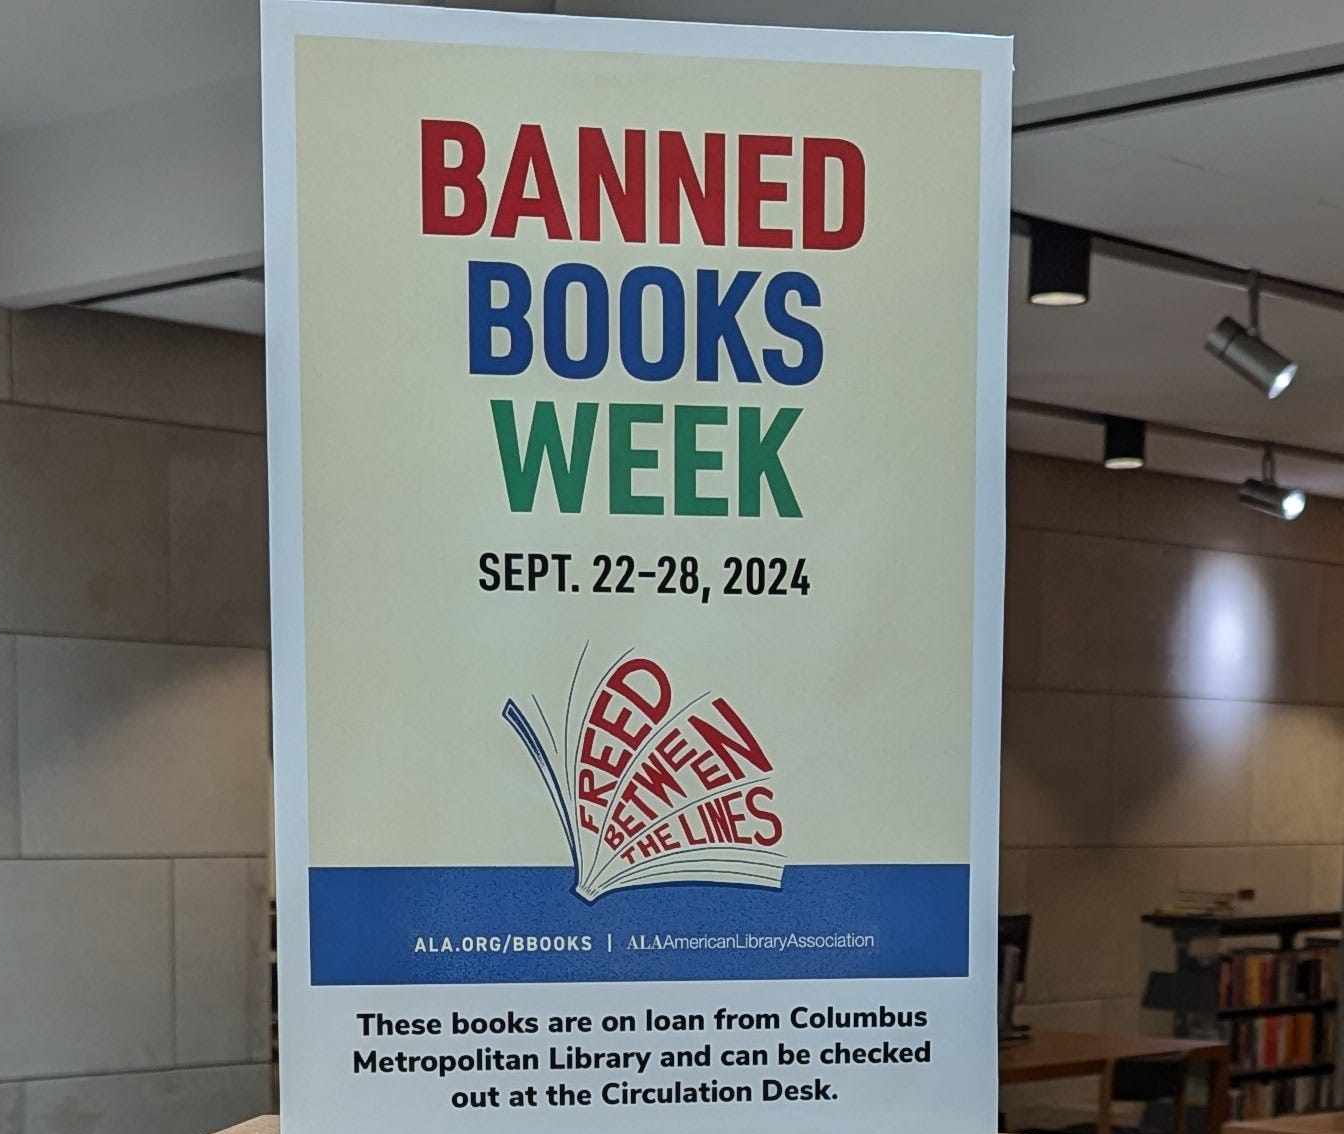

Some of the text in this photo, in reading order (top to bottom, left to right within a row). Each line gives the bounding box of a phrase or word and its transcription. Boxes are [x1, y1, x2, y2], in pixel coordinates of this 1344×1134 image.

[420, 118, 866, 251] BANNED
[468, 259, 824, 386] BOOKS
[489, 399, 805, 519] WEEK
[478, 553, 580, 593] SEPT.
[723, 557, 811, 596] 2024
[578, 658, 672, 834] FREED
[604, 697, 774, 851] BETWEEN
[620, 786, 783, 864] THE LINES
[414, 934, 593, 953] ALA.ORG/BBOOKS
[353, 1041, 931, 1077] Metropolitan Library and can be checked
[356, 1006, 928, 1036] These books are on loan from Columbus
[451, 1078, 838, 1109] out at the Circulation Desk.
